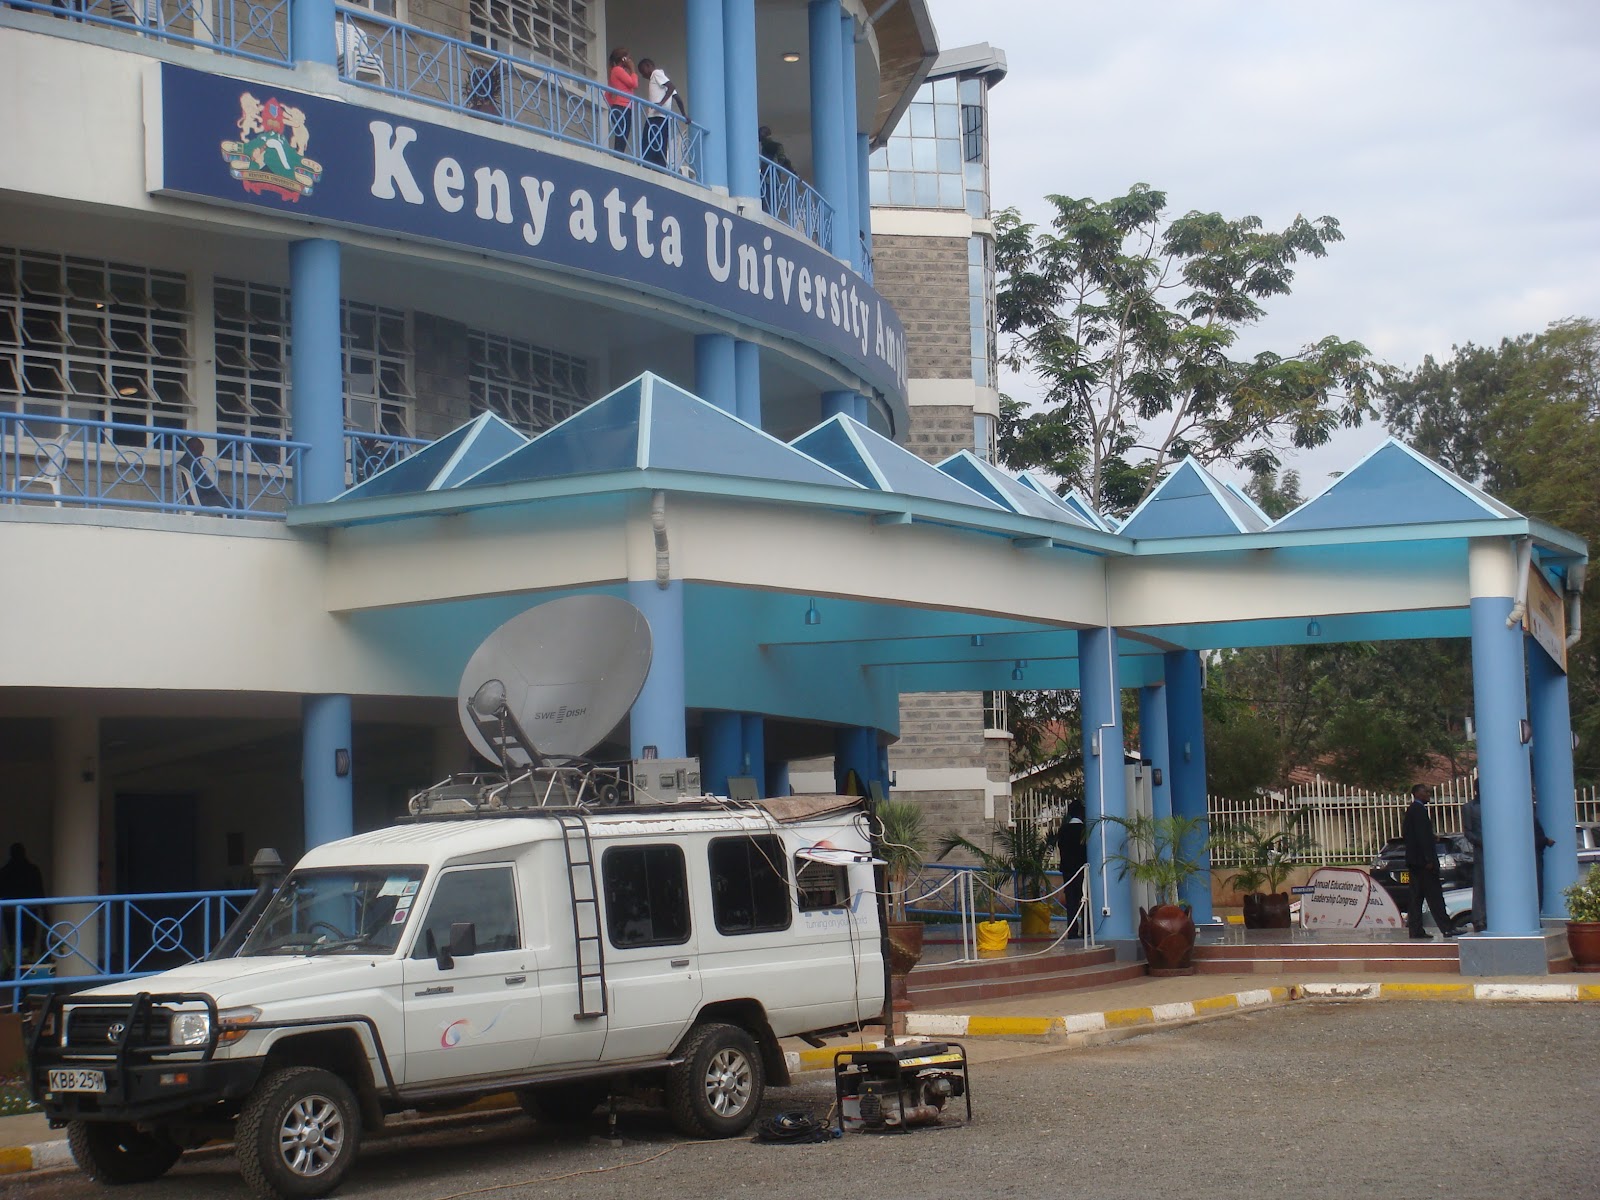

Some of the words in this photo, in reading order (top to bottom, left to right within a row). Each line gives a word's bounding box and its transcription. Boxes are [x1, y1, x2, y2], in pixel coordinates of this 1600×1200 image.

[368, 120, 684, 268] Kenyatta
[705, 211, 871, 356] University
[535, 712, 556, 720] SWE
[566, 708, 587, 718] DISH
[1314, 879, 1330, 889] Annual
[1330, 880, 1354, 891] Education
[1353, 883, 1365, 892] and
[1311, 894, 1336, 905] Leadership
[1336, 895, 1359, 907] Congress
[50, 1072, 75, 1089] KBB
